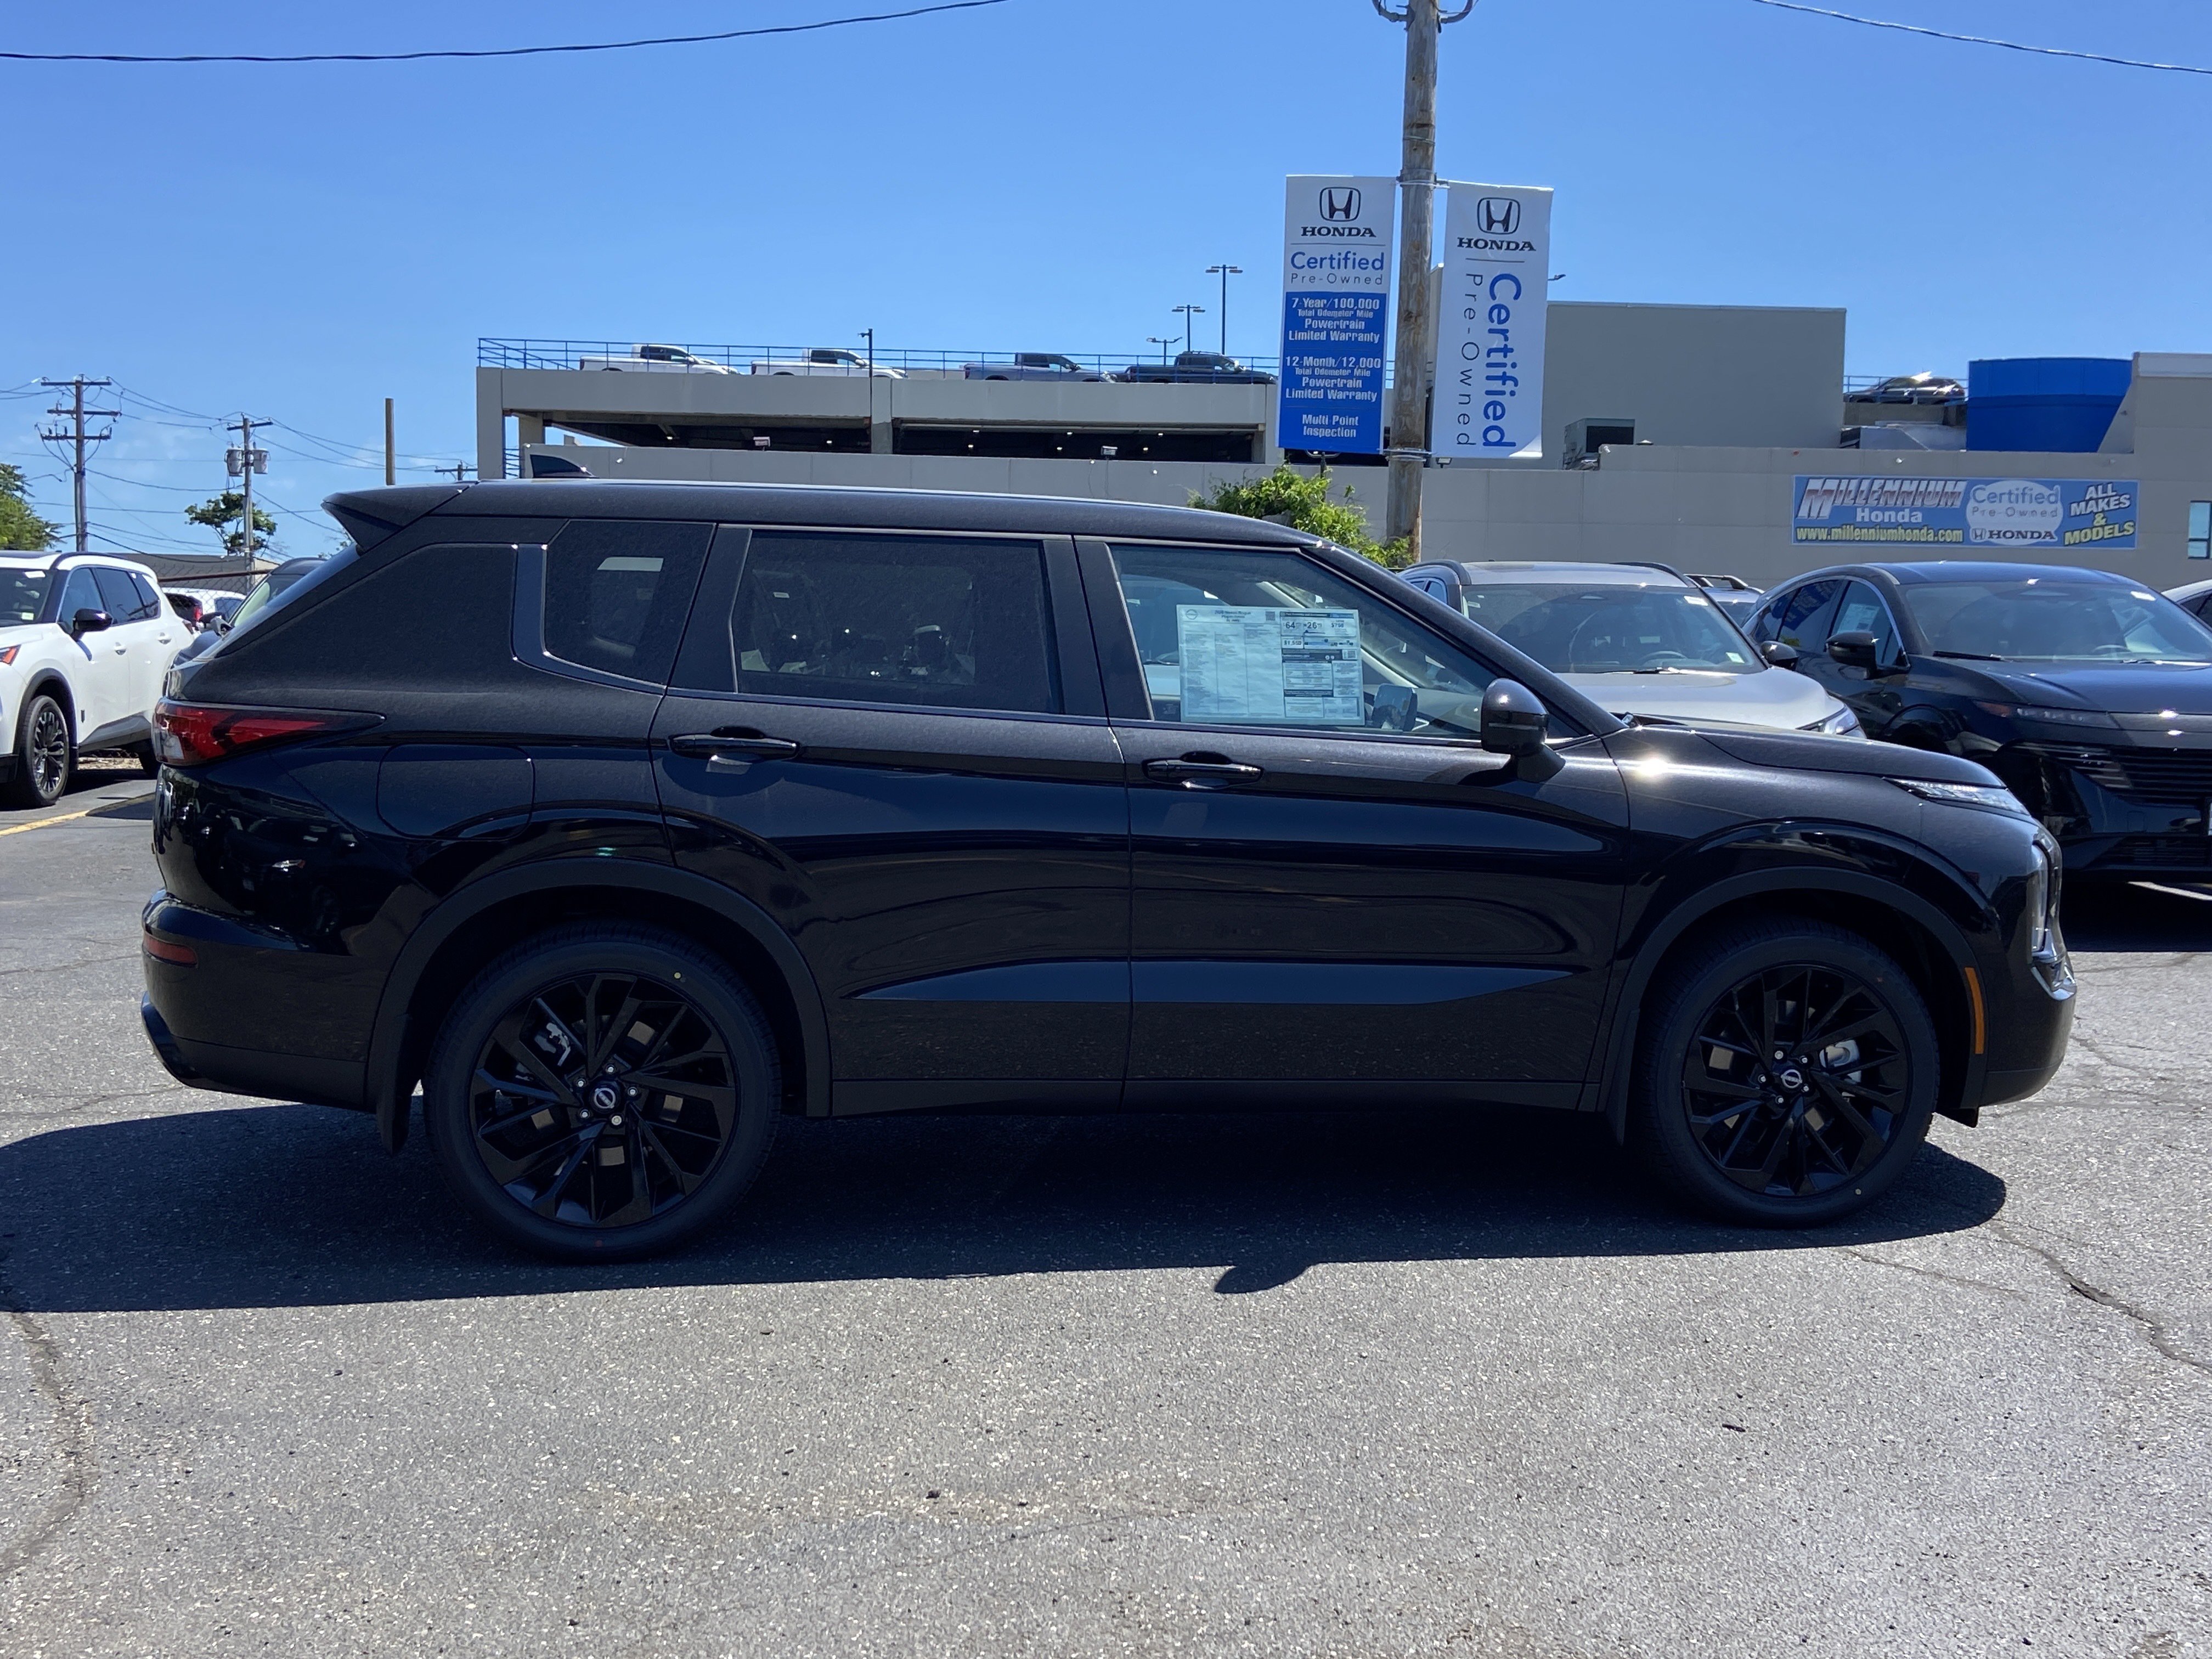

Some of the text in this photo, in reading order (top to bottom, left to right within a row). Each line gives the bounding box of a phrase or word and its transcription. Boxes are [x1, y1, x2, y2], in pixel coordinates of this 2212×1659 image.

[1301, 226, 1376, 238] HONDA
[1457, 237, 1536, 251] HONDA
[1291, 251, 1384, 271] Certified
[1290, 273, 1383, 285] Pre-Owned
[1298, 309, 1374, 318] Total Odometer Mile
[1305, 318, 1365, 329] Powertrain
[1289, 330, 1380, 343] Limited Warranty
[1286, 356, 1381, 368] 12-Month/12,000
[1457, 274, 1483, 446] Pre-Owned
[1482, 273, 1522, 448] Certified
[1314, 368, 1351, 376] Odometer
[1354, 368, 1370, 377] Mile
[1302, 376, 1362, 388] Powertrain
[1286, 388, 1378, 402] Limited Warranty
[1302, 414, 1359, 426] Multi Point
[1303, 426, 1357, 438] Inspection
[1972, 485, 2058, 504] Certified
[2086, 483, 2117, 500] ALL
[1795, 478, 1967, 520] MILLENNIUM
[2070, 494, 2131, 516] MAKES
[1856, 507, 1922, 523] Honda
[1972, 506, 2058, 518] Pre-Owned
[2094, 512, 2107, 527] &
[1796, 524, 1963, 542] www.millenniumhonda.com
[1988, 530, 2056, 539] HONDA
[2064, 522, 2136, 545] MODELS
